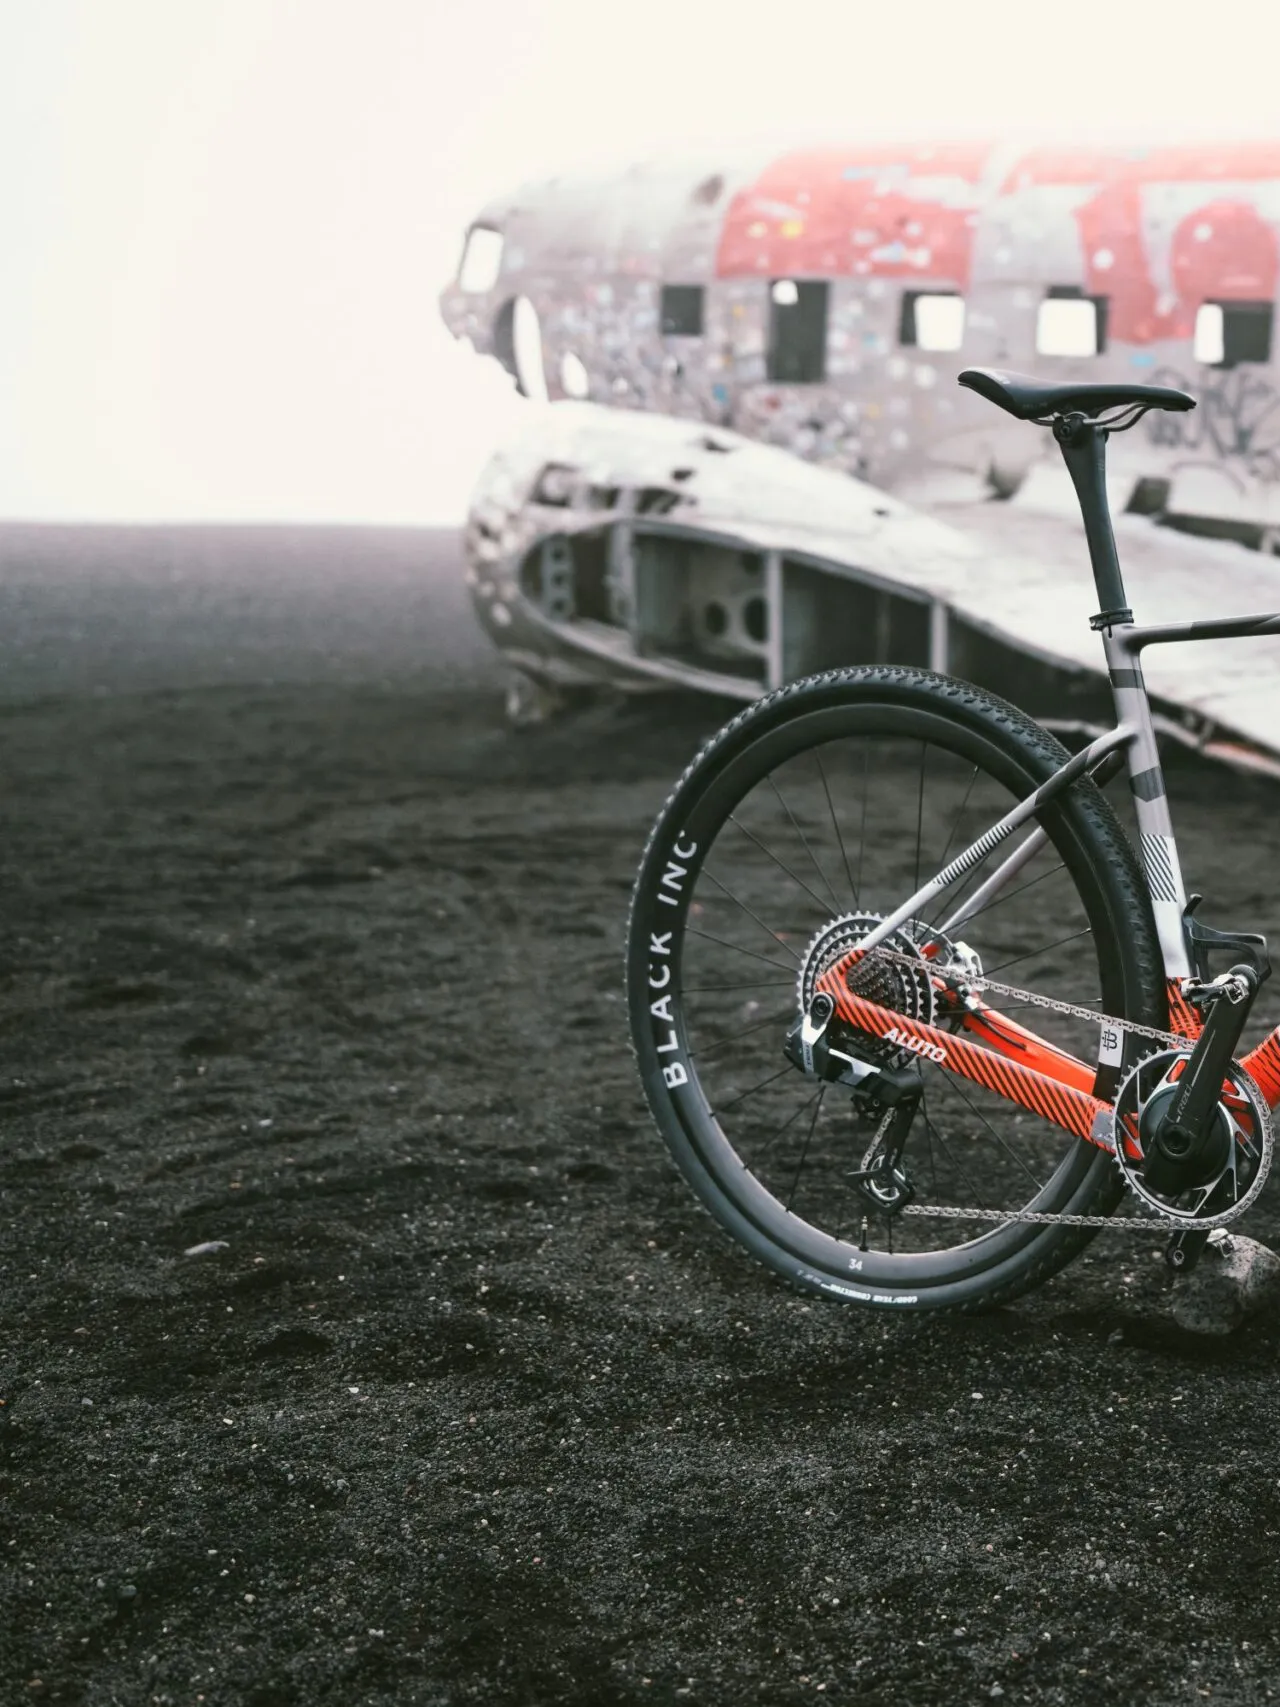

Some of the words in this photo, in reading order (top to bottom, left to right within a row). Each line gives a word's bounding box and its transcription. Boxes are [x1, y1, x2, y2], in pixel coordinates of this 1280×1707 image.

[657, 829, 698, 907] INC
[648, 931, 689, 1089] BLACK
[881, 1027, 948, 1063] ALUTO
[848, 1258, 863, 1271] 34
